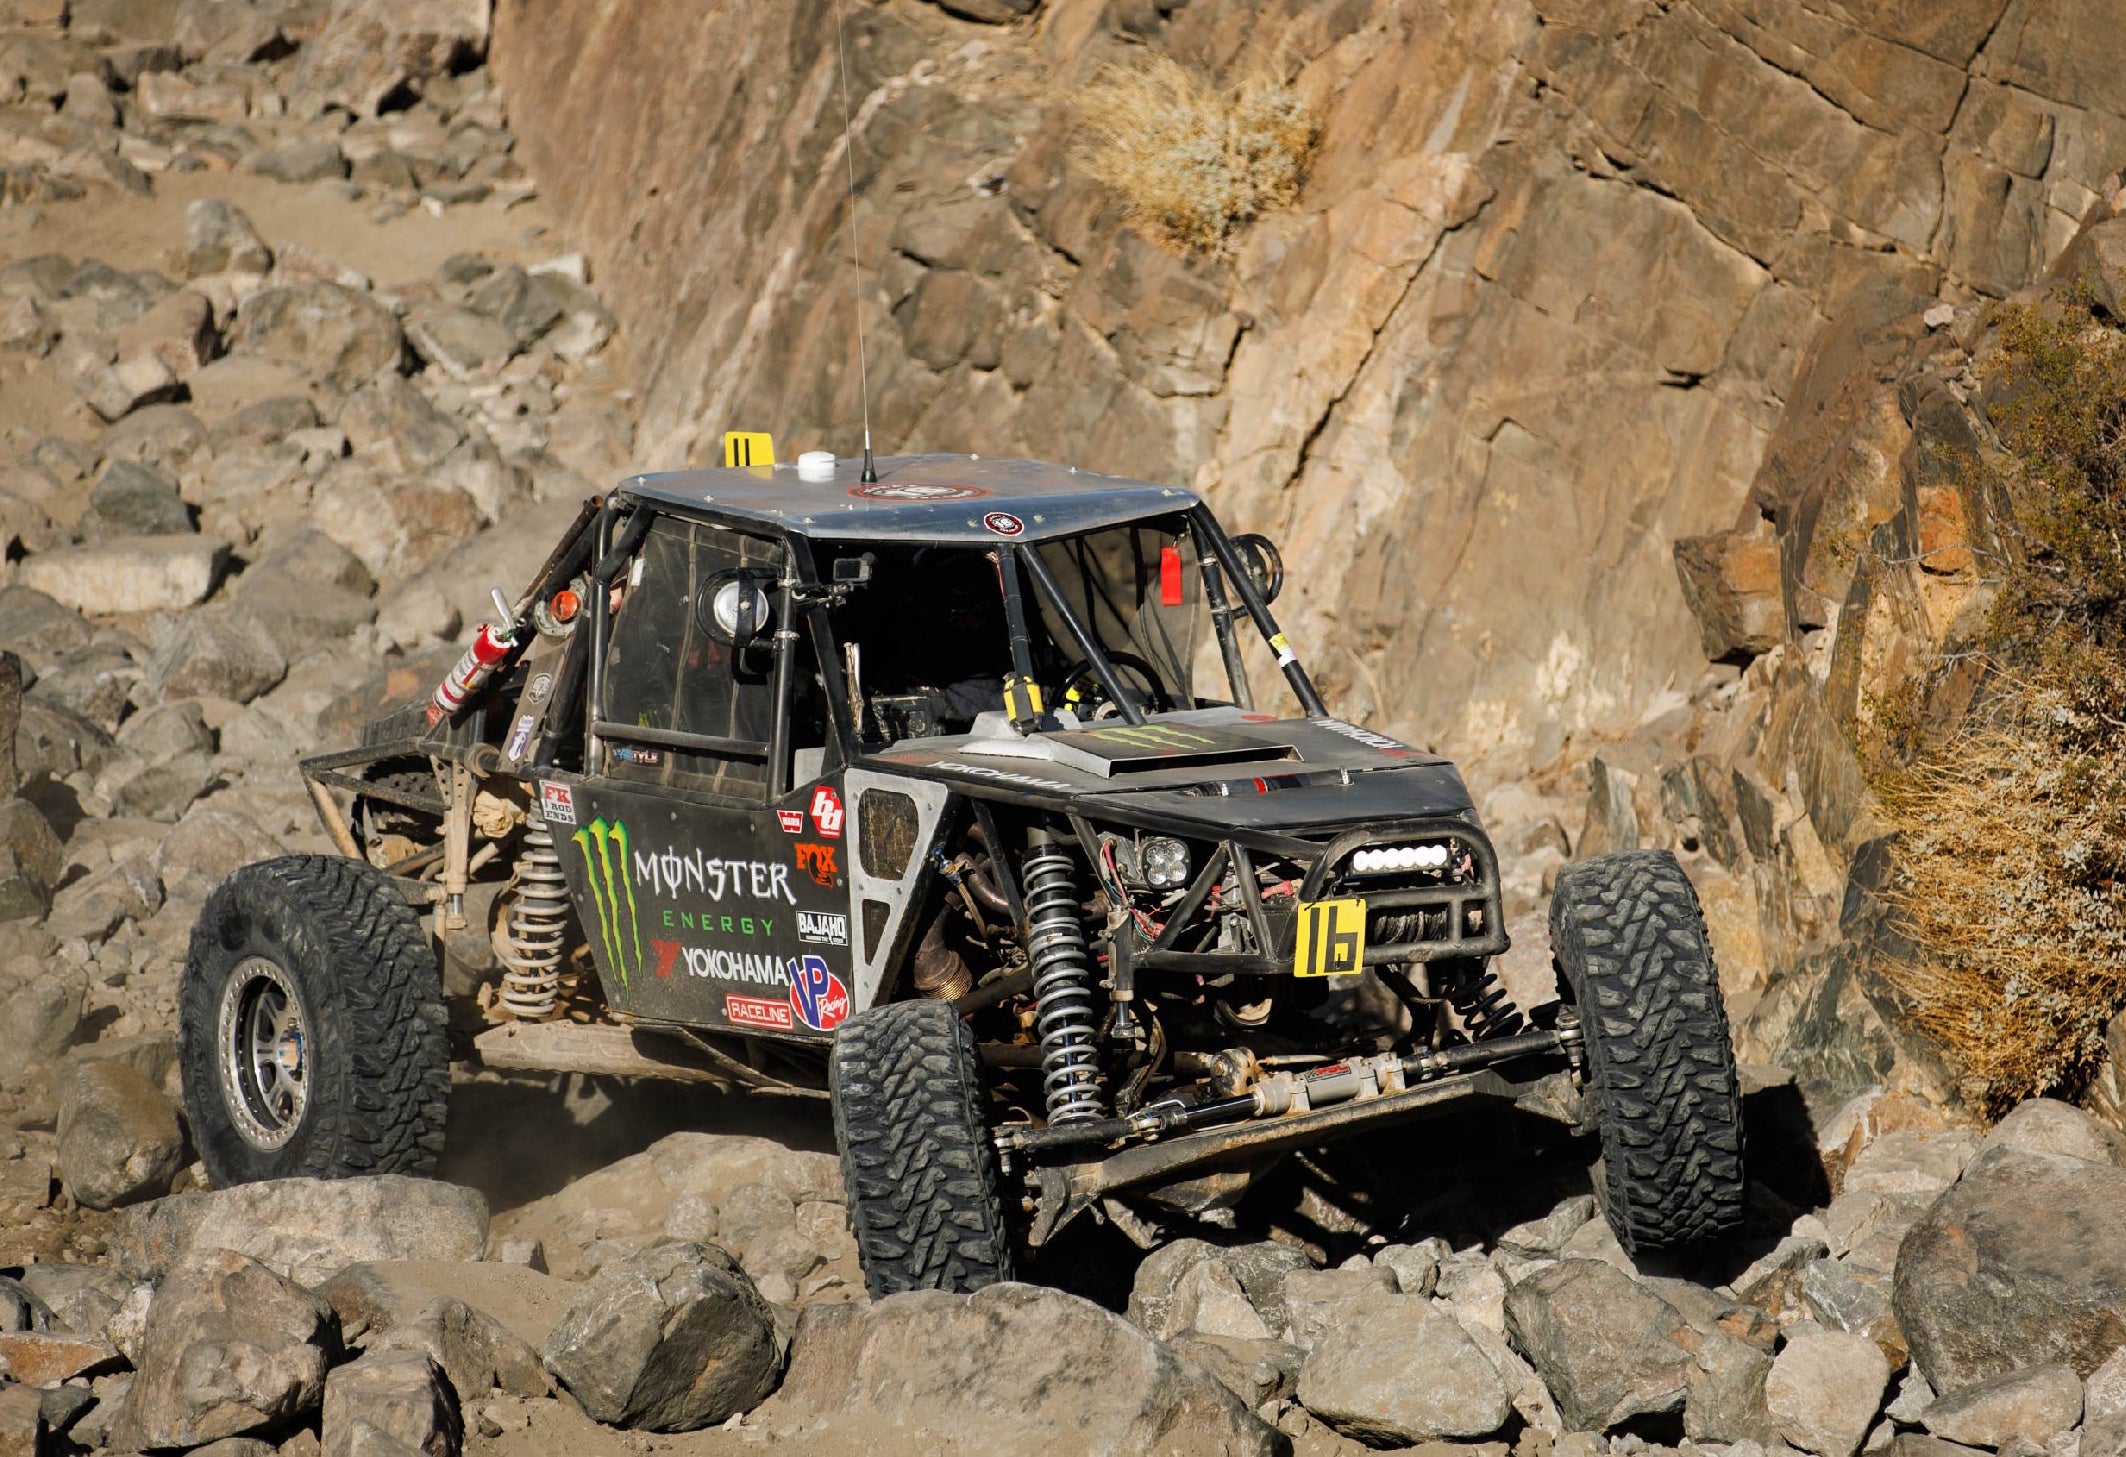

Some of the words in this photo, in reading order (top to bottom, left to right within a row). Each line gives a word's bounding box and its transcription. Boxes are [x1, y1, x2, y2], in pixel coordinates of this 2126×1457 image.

[546, 810, 574, 822] ENDS
[633, 845, 797, 906] MONSTER
[795, 842, 837, 882] FOX
[663, 910, 773, 936] ENERGY
[1307, 905, 1358, 974] 16
[682, 946, 790, 987] YOKOHAMA
[731, 1002, 790, 1023] RACELINE
[786, 955, 830, 1030] VP
[820, 996, 848, 1019] Racing
